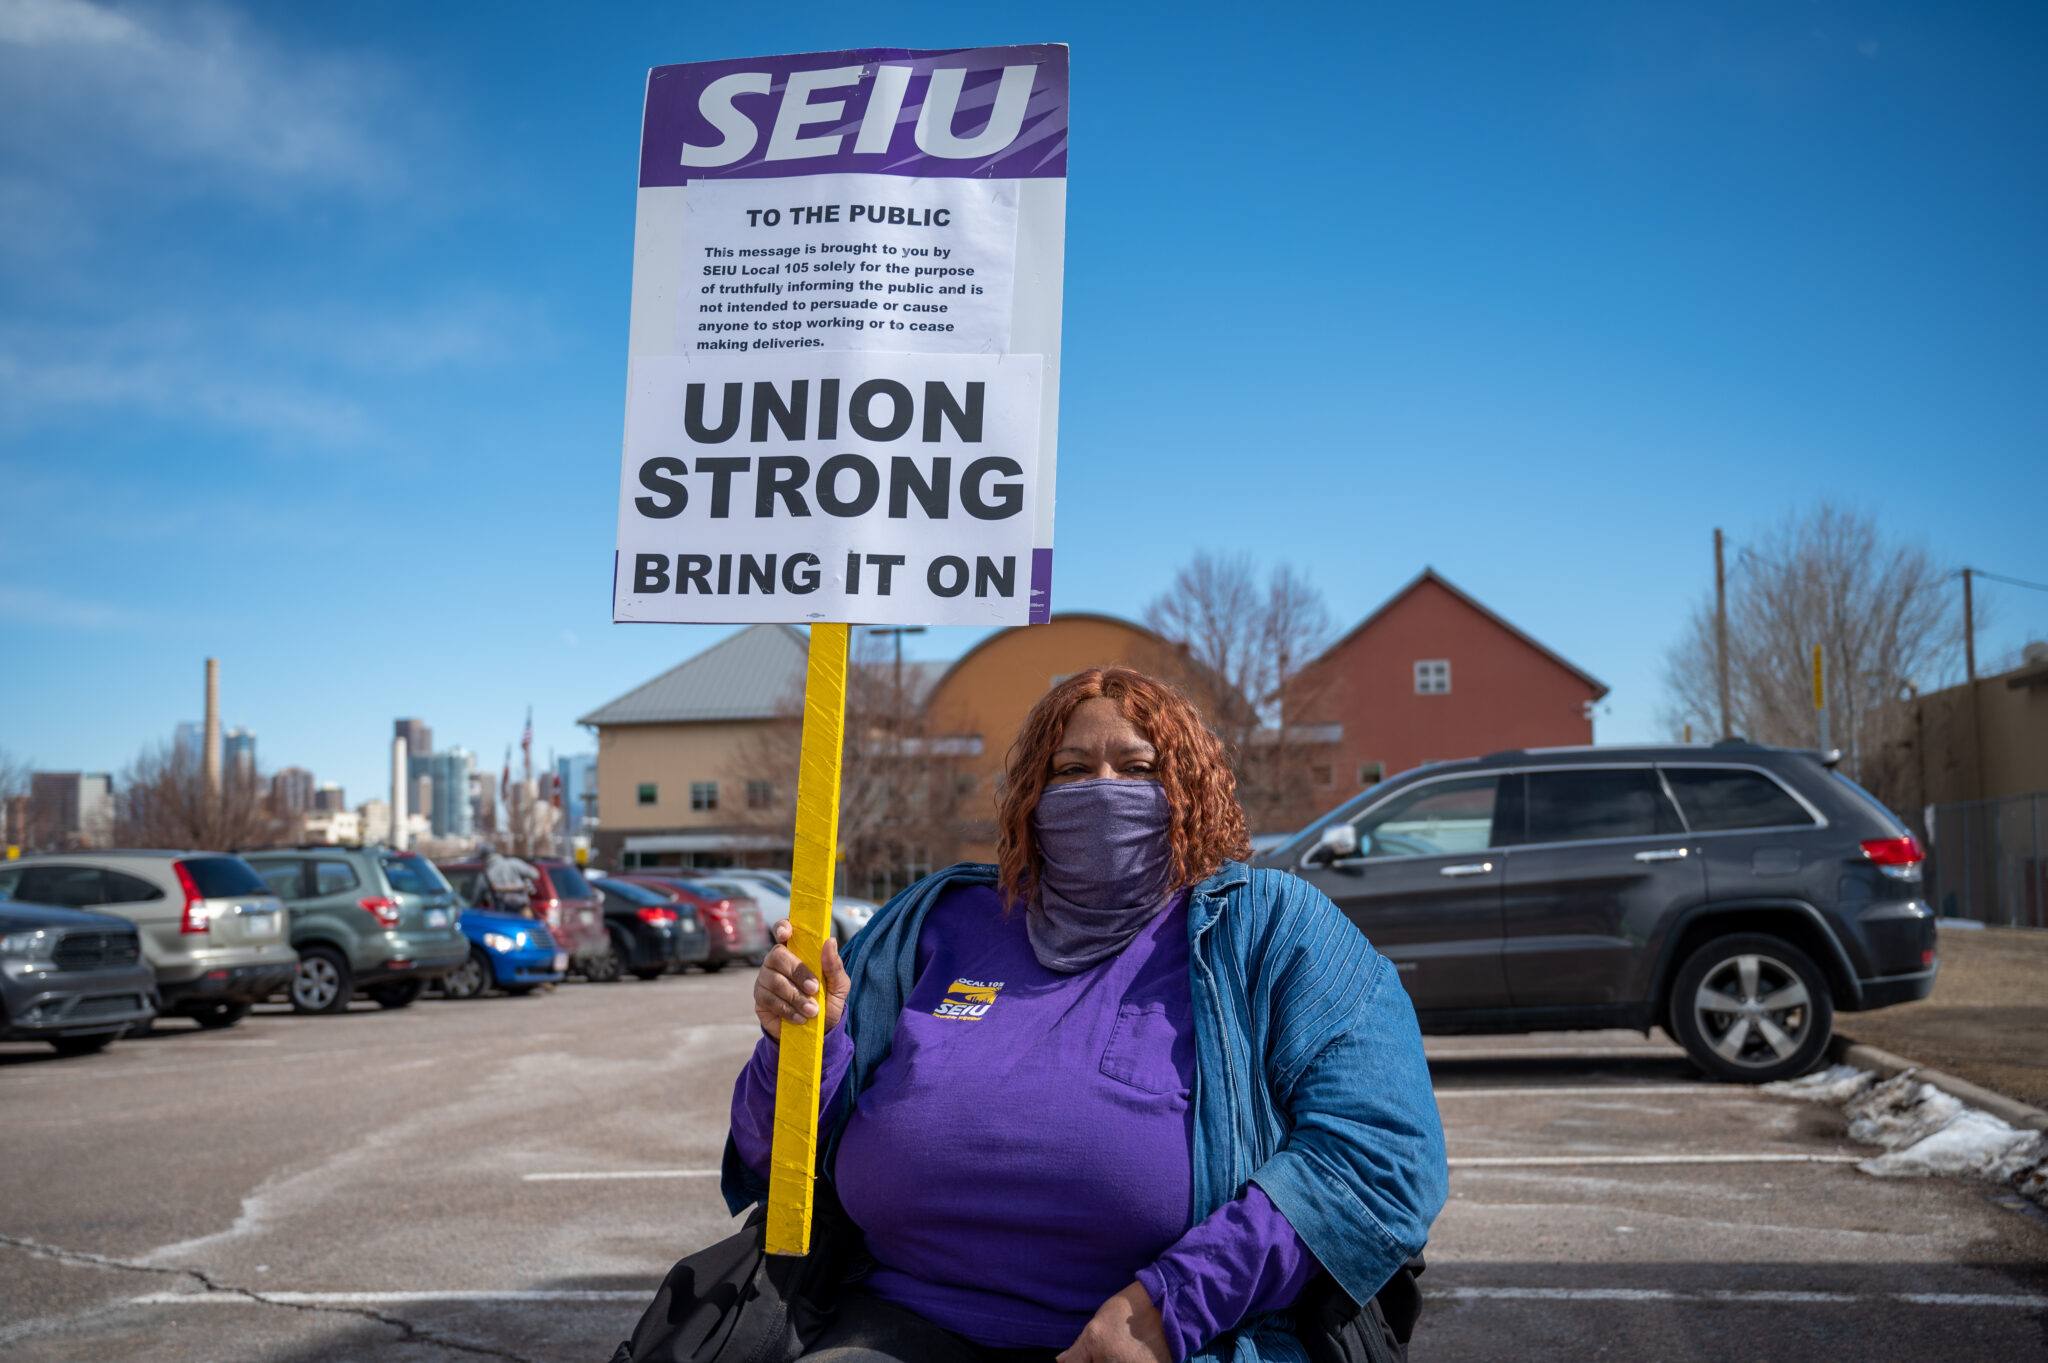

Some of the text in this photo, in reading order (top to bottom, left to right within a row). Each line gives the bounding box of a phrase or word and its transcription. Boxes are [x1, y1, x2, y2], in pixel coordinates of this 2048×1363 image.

[680, 64, 1038, 167] SEIU
[746, 204, 951, 228] TO THE PUBLIC
[704, 242, 951, 260] This message is brought to you by
[702, 260, 975, 278] SEIU Local 105 solely for the purpose
[700, 279, 984, 296] of truthfully informing the public and is
[699, 298, 948, 313] not intended to persuade or cause
[697, 316, 955, 334] anyone to stop working or to cease
[696, 336, 825, 353] making deliveries.
[684, 379, 985, 444] UNION
[635, 454, 1023, 520] STRONG
[633, 553, 1016, 597] BRING IT ON
[934, 1003, 992, 1016] SEIU
